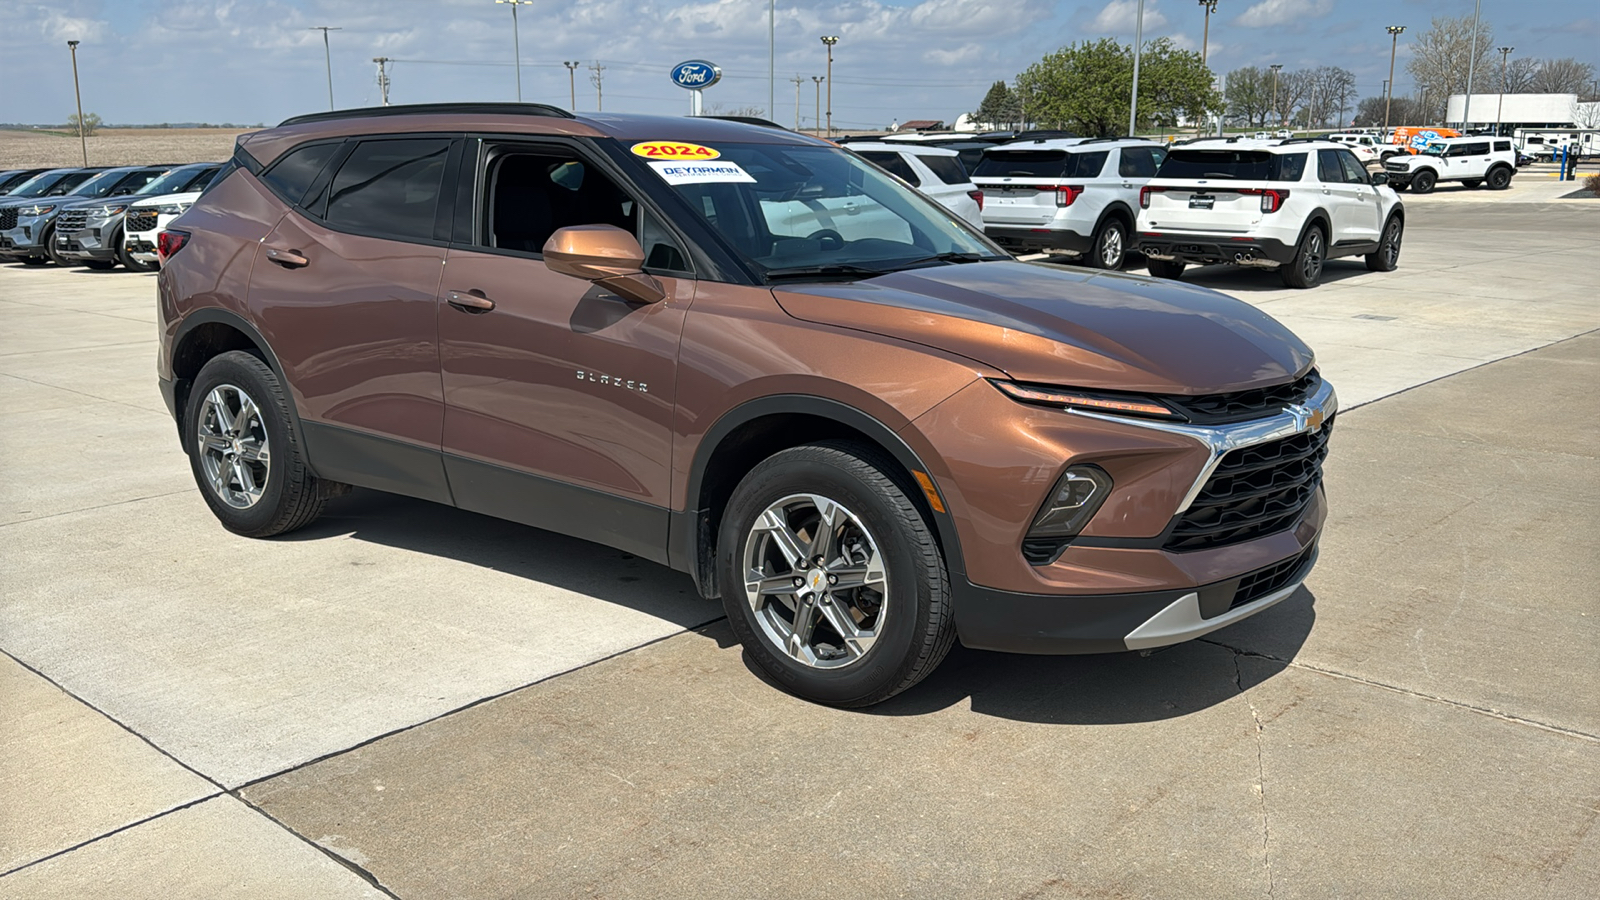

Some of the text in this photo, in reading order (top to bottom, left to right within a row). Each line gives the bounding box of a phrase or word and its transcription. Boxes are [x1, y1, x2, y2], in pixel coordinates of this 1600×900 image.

[679, 66, 706, 83] Ford
[642, 146, 713, 156] 2024
[576, 370, 648, 392] BLAZER
